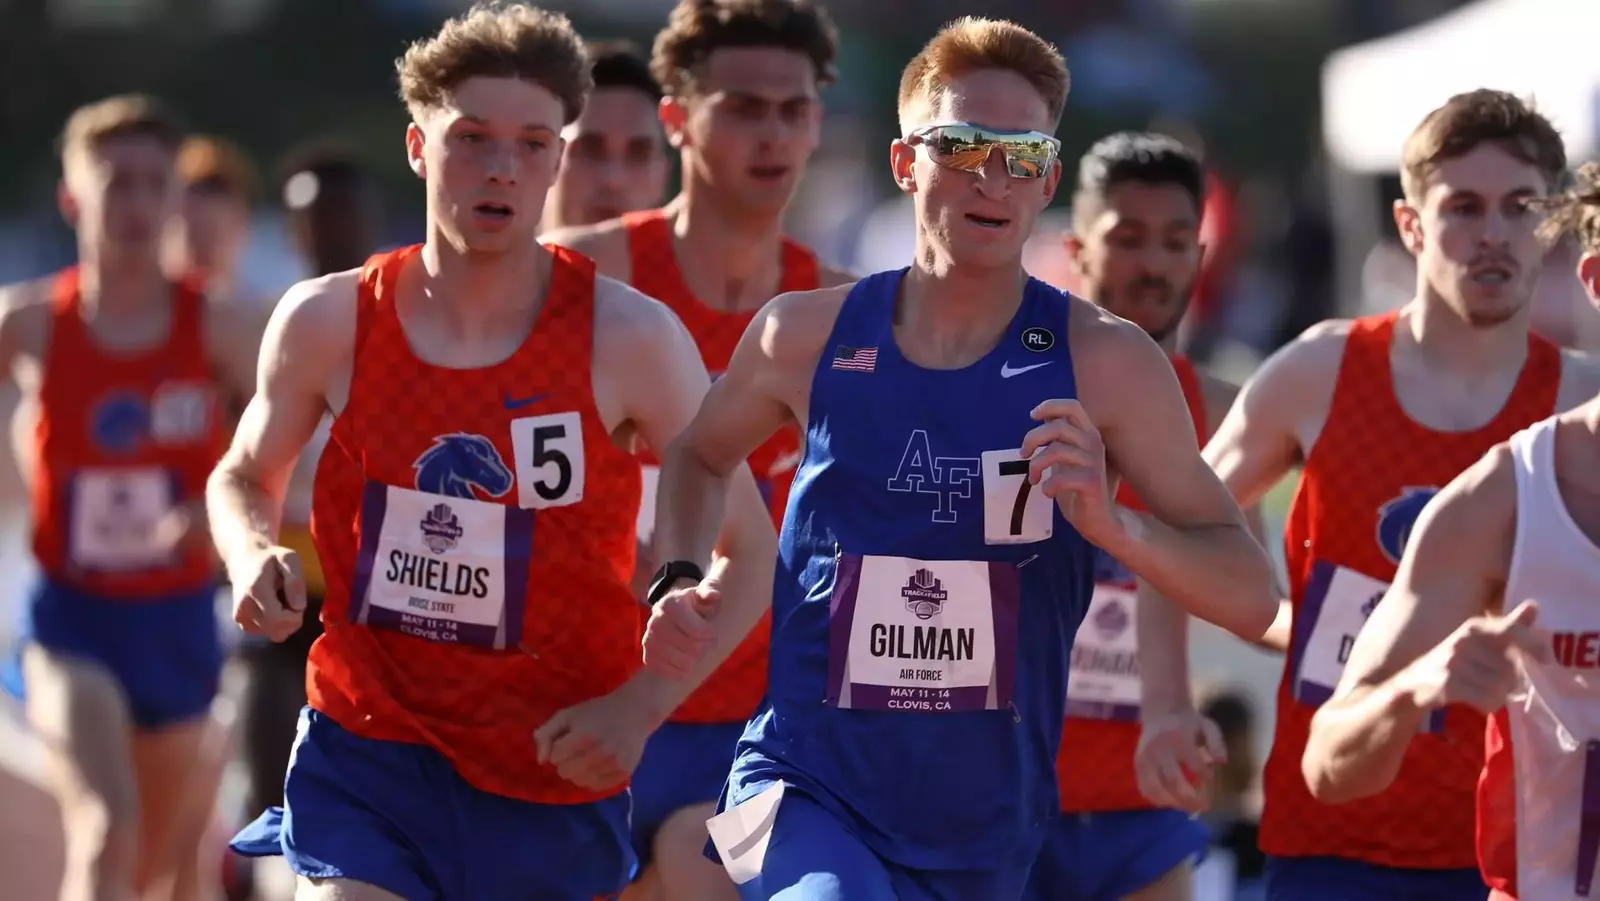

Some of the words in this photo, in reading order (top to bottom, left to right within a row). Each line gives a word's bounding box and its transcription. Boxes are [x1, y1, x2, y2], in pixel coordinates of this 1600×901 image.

[1028, 333, 1047, 346] RL
[532, 424, 572, 501] 5
[887, 429, 980, 523] AF
[998, 459, 1034, 536] 7
[386, 549, 490, 599] SHIELDS
[431, 601, 456, 613] STATE
[401, 614, 424, 626] MAY
[427, 619, 437, 629] 11
[442, 631, 458, 641] CA
[869, 622, 975, 661] GILMAN
[899, 668, 914, 680] AIR
[916, 669, 943, 681] FORCE
[890, 687, 915, 698] MAY
[919, 689, 929, 698] 11
[938, 689, 950, 698] 14
[887, 699, 933, 711] CLOVIS,
[935, 701, 952, 710] CA
